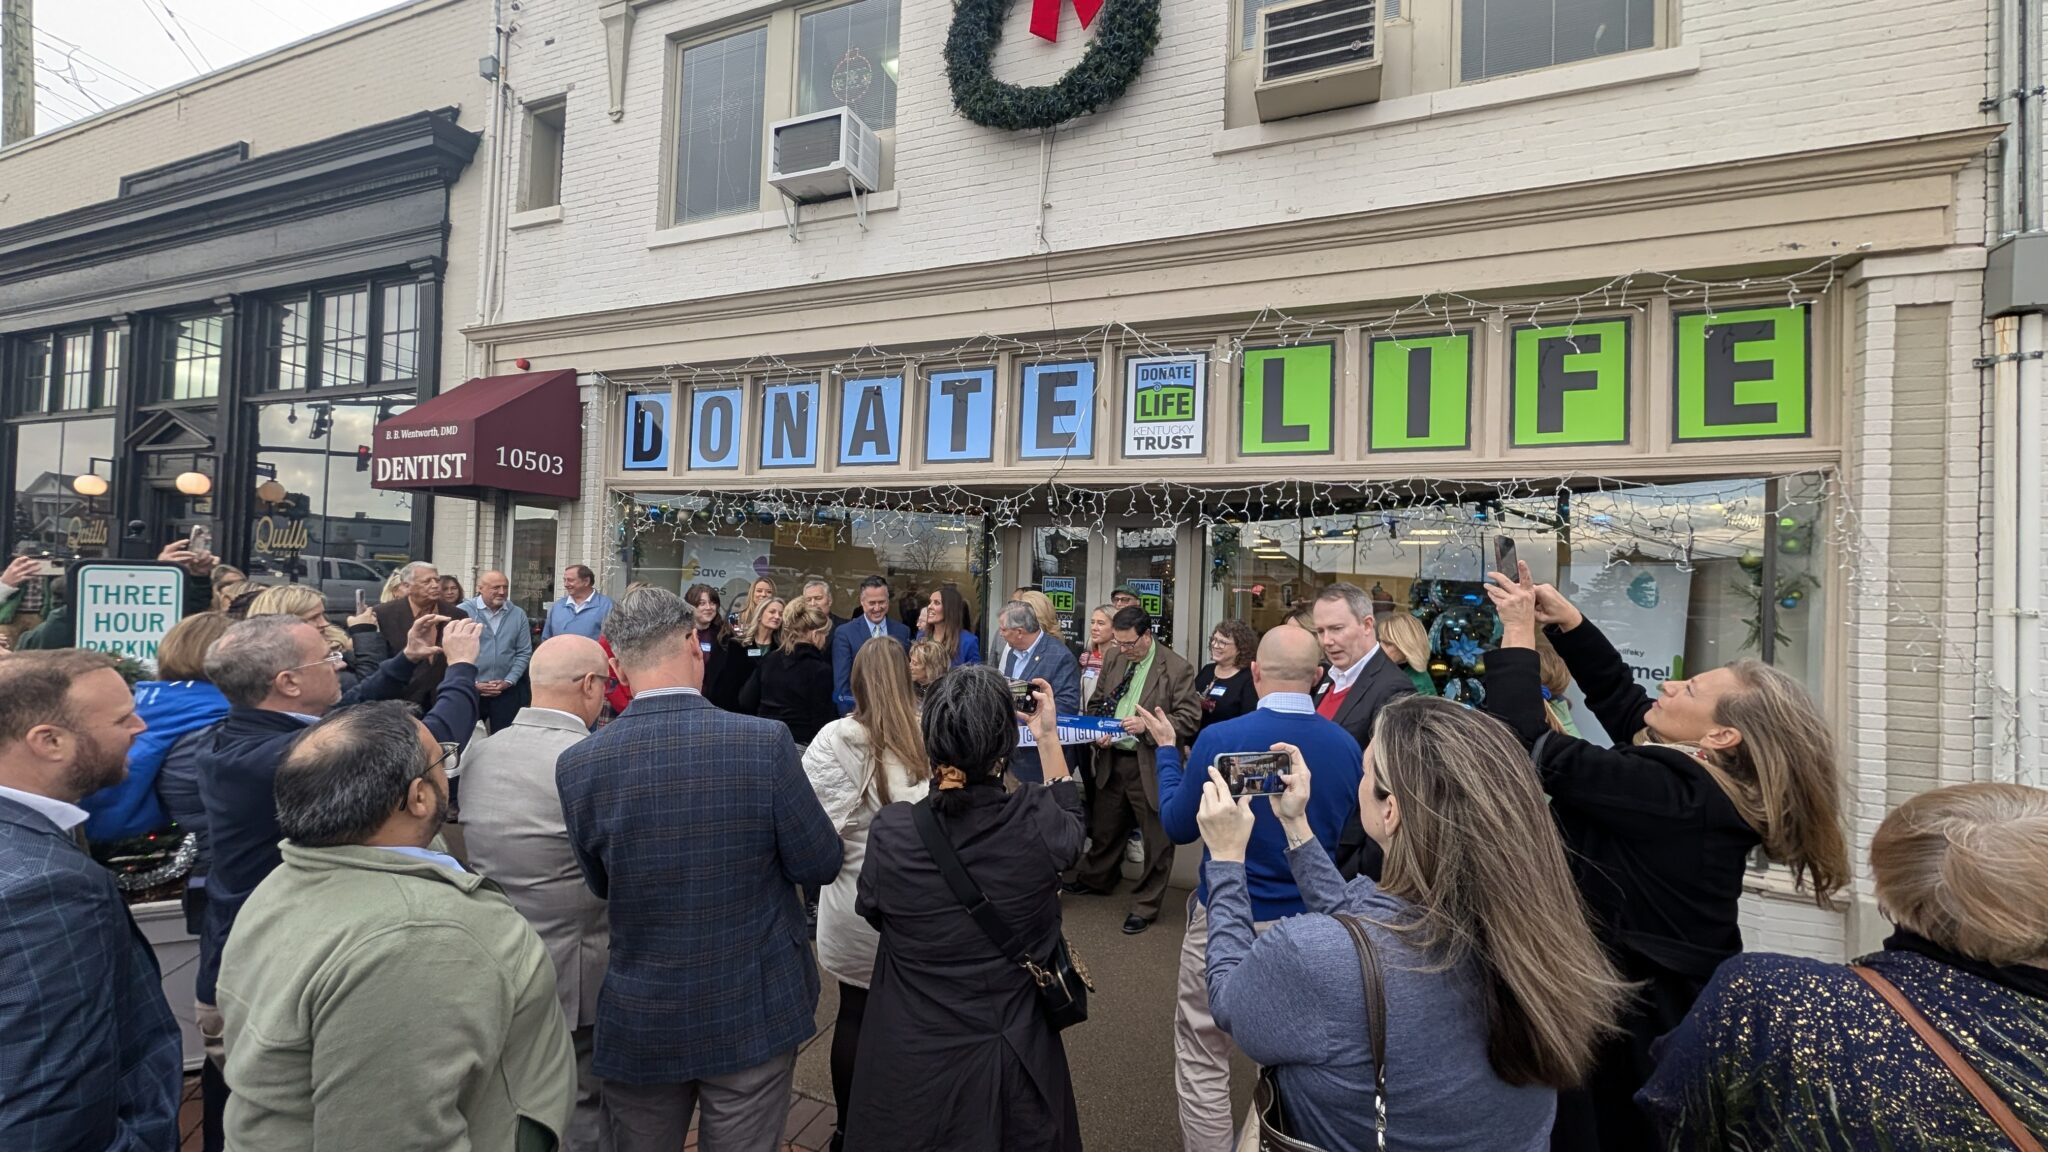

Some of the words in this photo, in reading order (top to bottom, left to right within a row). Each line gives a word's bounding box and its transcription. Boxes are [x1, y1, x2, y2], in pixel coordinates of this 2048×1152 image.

[1141, 365, 1191, 381] DONATE
[633, 371, 1078, 463] DONATE
[1261, 319, 1778, 444] LIFE
[1140, 392, 1190, 417] LIFE
[401, 427, 440, 440] Wentworth,
[440, 425, 458, 437] DMD
[1133, 424, 1194, 436] KENTUCKY
[1133, 434, 1194, 451] TRUST
[377, 452, 467, 482] DENTIST
[495, 445, 564, 475] 10503
[66, 515, 108, 549] Quills
[255, 515, 308, 554] Quills
[692, 565, 727, 578] Save
[1045, 580, 1072, 589] DONATE
[88, 584, 173, 606] THREE
[1046, 594, 1072, 608] IFE
[94, 612, 165, 633] HOUR
[86, 640, 158, 659] PARKIN
